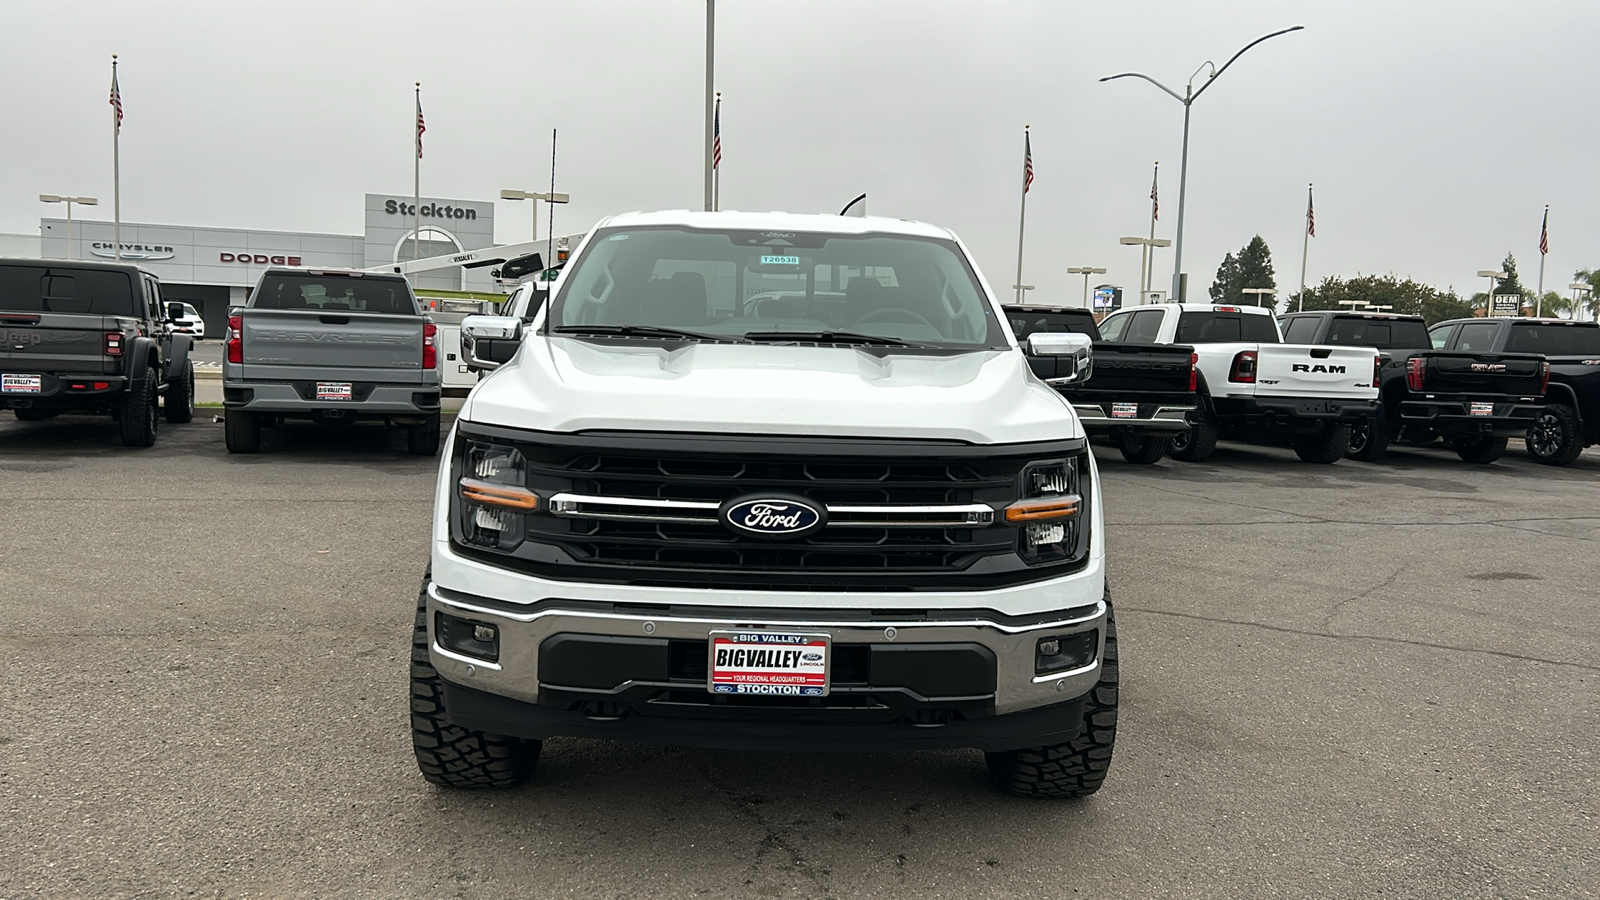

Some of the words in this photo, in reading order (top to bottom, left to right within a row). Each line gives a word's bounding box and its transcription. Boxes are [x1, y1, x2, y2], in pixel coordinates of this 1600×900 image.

[385, 200, 476, 220] Stockton
[92, 242, 174, 252] CHRYSLER
[220, 252, 302, 266] DODGE
[0, 329, 41, 346] Jeep
[256, 330, 412, 345] CHEVROLET
[1292, 364, 1346, 374] RAM
[744, 503, 802, 528] Ford
[739, 634, 759, 642] BIG
[762, 635, 802, 643] VALLEY
[716, 648, 803, 668] BIGVALLEY
[737, 685, 801, 694] STOCKTON
